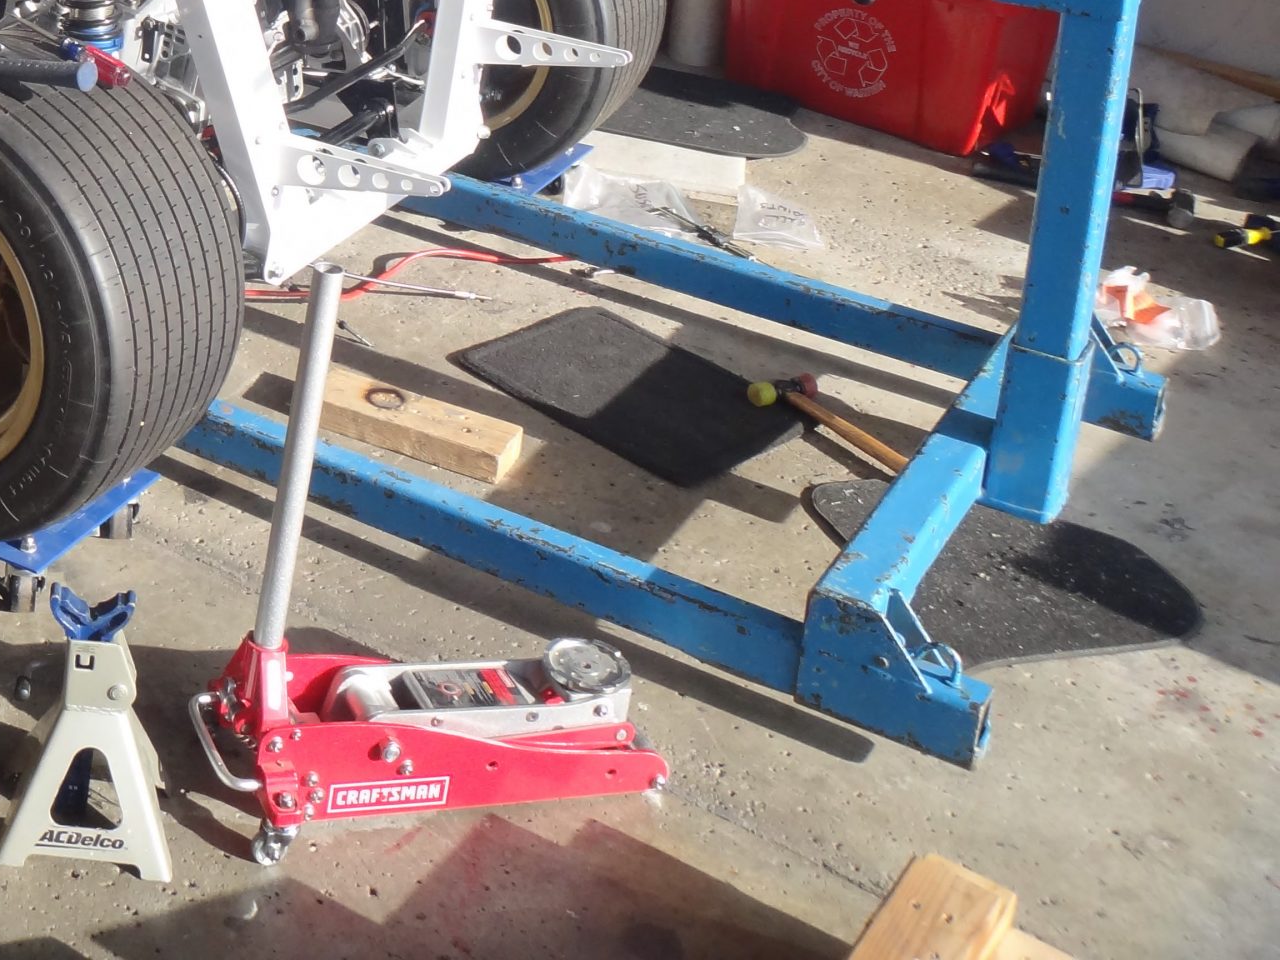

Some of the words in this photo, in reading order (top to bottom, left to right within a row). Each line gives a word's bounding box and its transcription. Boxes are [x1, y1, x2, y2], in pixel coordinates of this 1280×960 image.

[814, 8, 868, 31] PROPERTY
[868, 16, 884, 29] OF
[881, 29, 897, 52] THE
[811, 59, 831, 84] CITY
[828, 80, 844, 92] OF
[336, 784, 441, 805] CRAFTSMAN
[38, 829, 125, 850] ACDelco
